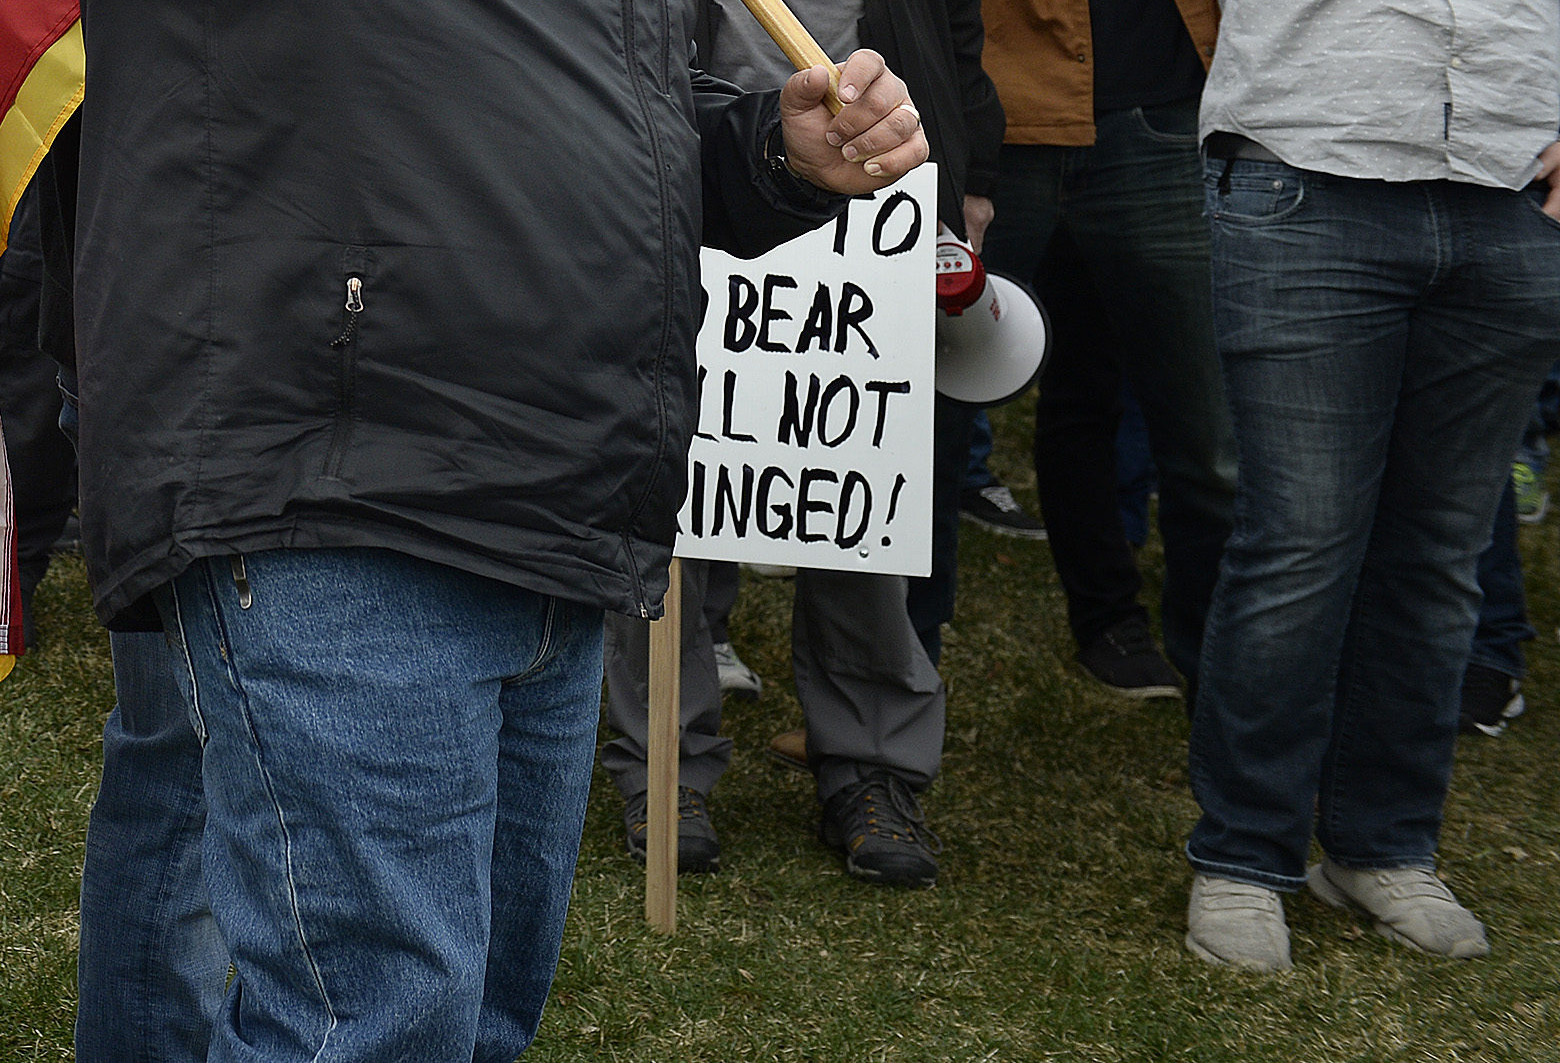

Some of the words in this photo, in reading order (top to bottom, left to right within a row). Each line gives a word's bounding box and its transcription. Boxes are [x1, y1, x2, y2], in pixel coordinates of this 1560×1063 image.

[833, 189, 922, 257] TO
[723, 273, 880, 361] BEAR
[777, 369, 911, 450] NOT
[677, 460, 907, 551] INGED!
